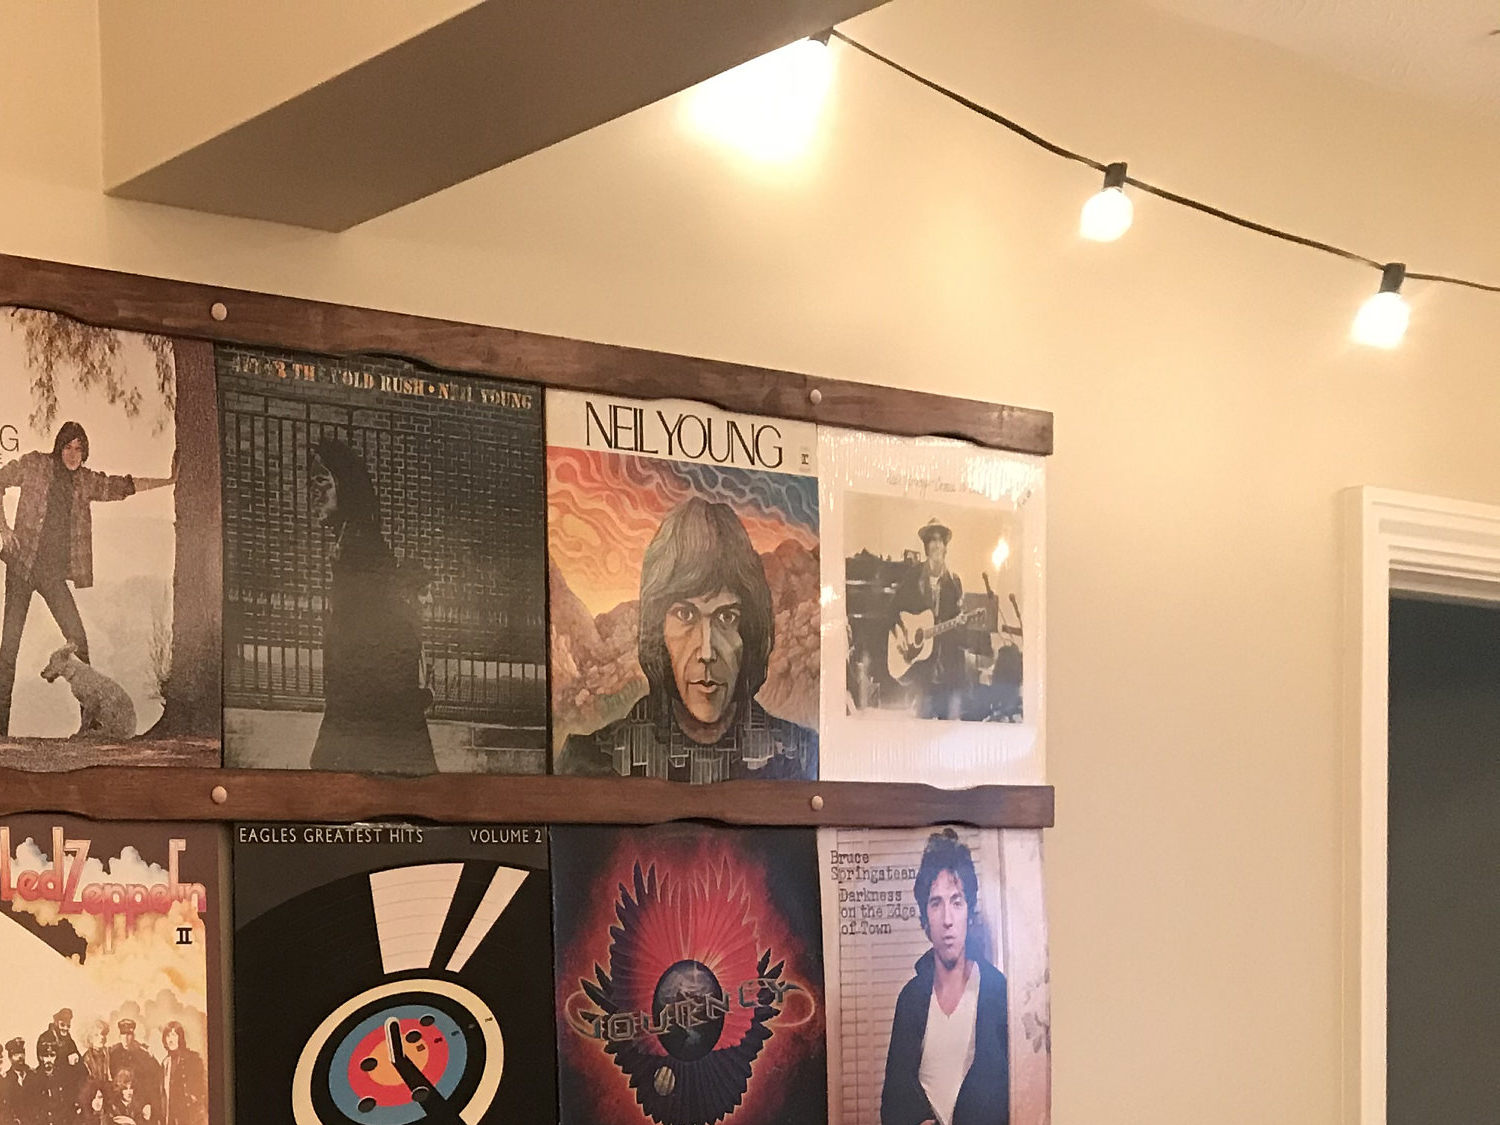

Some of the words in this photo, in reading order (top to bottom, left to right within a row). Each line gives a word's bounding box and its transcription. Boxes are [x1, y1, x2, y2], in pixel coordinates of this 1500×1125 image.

[380, 374, 425, 396] RUSH
[481, 388, 532, 409] YOUNG
[585, 401, 659, 455] NEIL
[656, 410, 783, 468] YOUNG
[239, 828, 297, 843] EAGLES
[303, 828, 382, 843] GREATEST
[389, 828, 424, 843] HITS
[469, 829, 529, 843] VOLUME
[534, 829, 542, 843] 2
[830, 850, 870, 864] Bruce
[831, 866, 916, 884] Springsteen
[58, 838, 207, 954] Zeppelin
[839, 888, 902, 902] Darkness
[841, 906, 856, 918] on
[861, 904, 883, 918] the
[886, 903, 916, 921] Edge
[176, 927, 193, 945] II
[841, 921, 857, 935] of
[860, 921, 892, 935] Town
